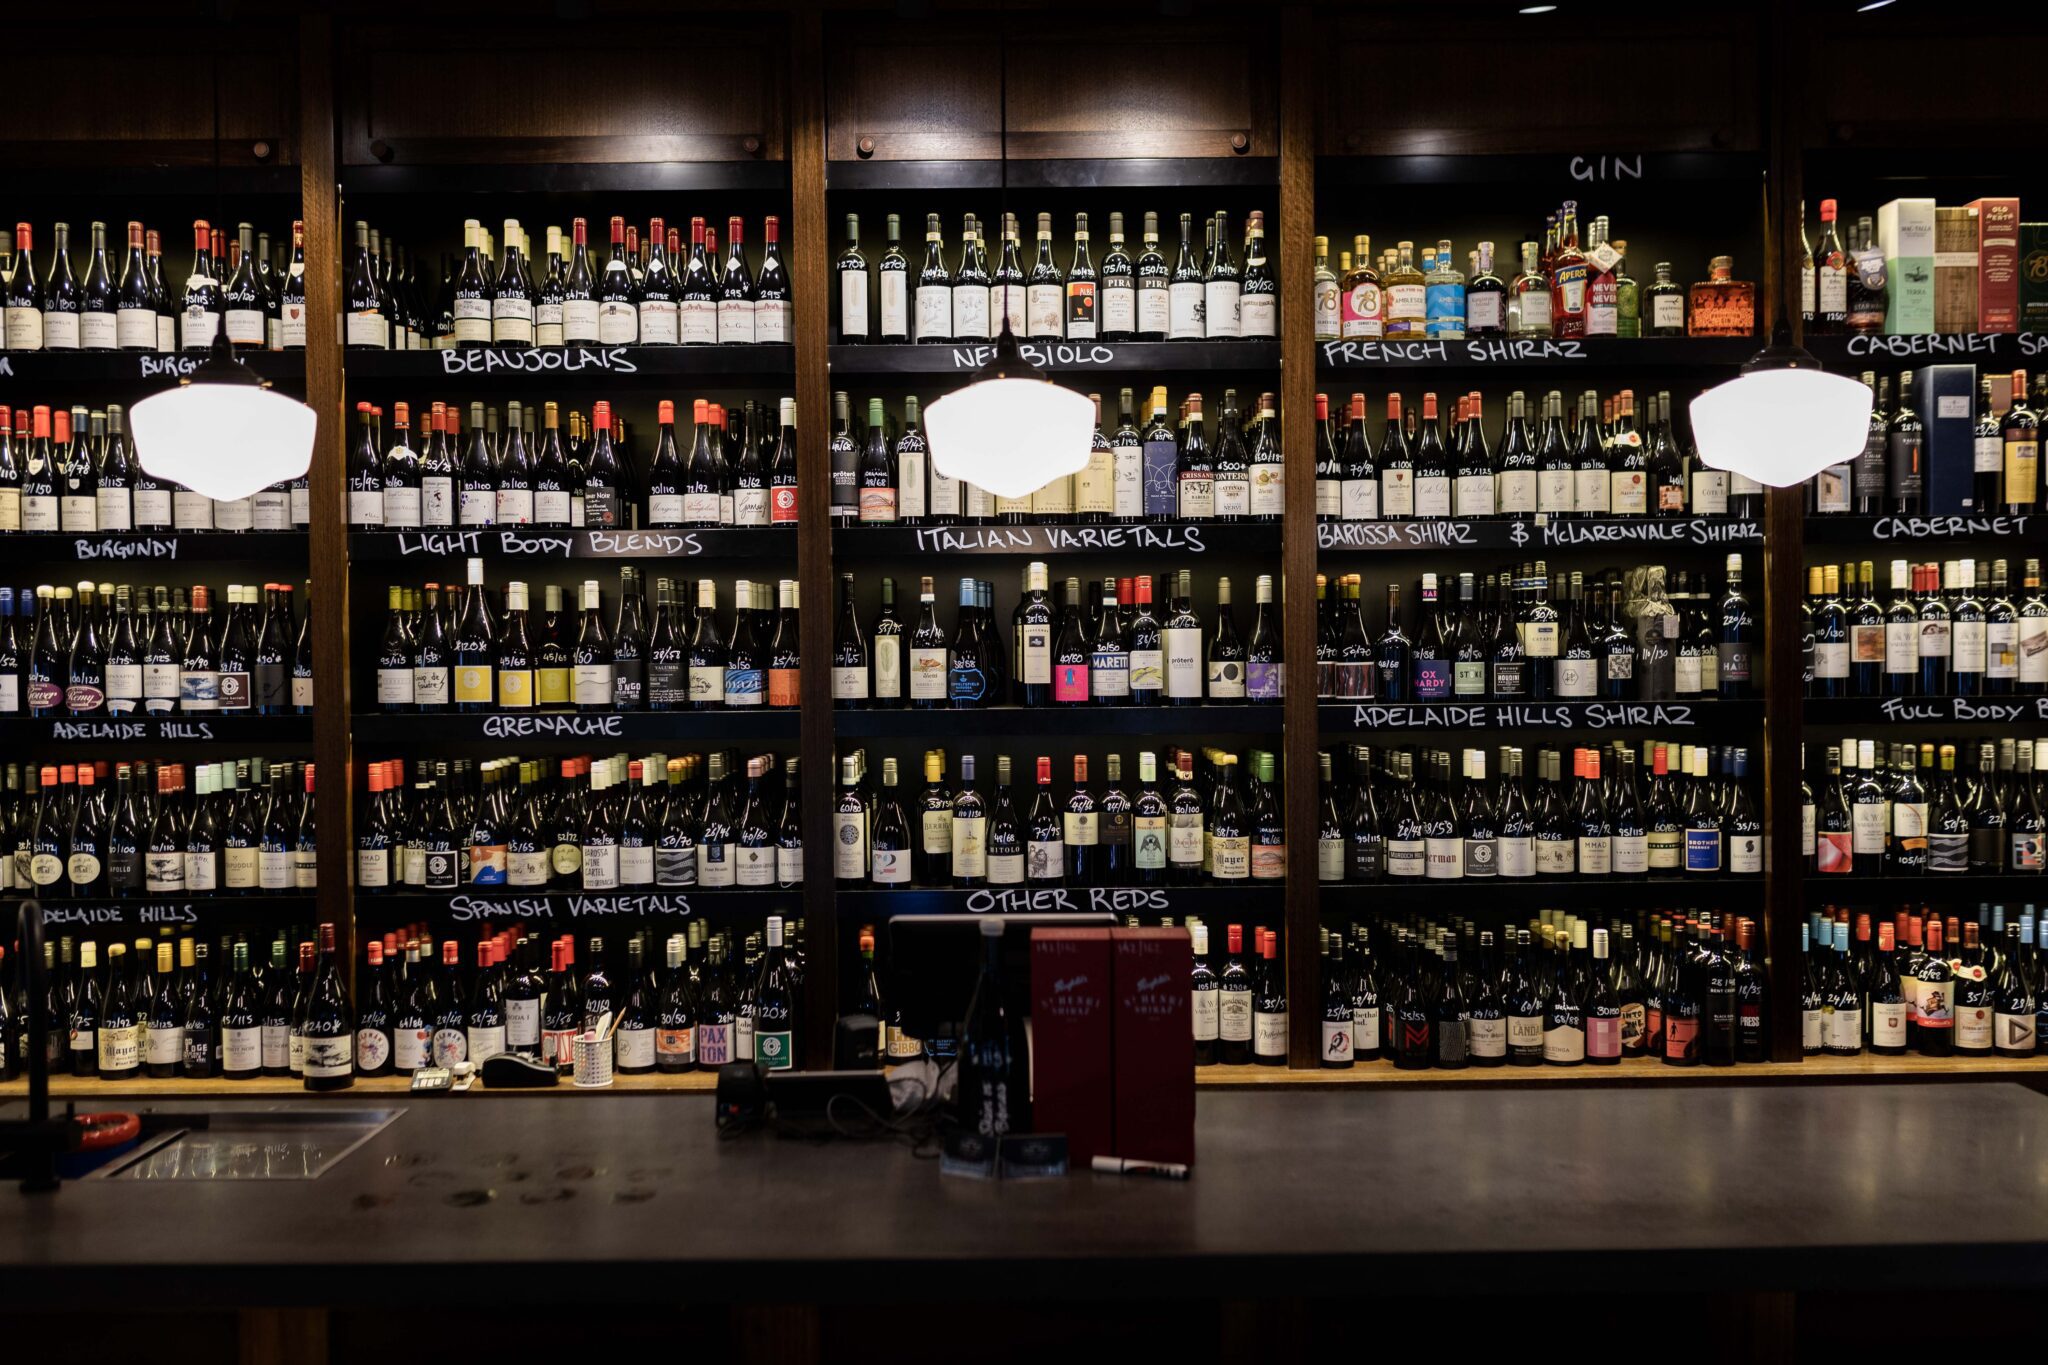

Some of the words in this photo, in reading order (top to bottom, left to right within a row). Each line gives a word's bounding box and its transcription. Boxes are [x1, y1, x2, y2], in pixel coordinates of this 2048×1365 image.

[1570, 156, 1642, 180] GIN
[1108, 279, 1132, 288] PIRA
[1146, 279, 1168, 288] PIRA
[1244, 277, 1274, 292] 130/150
[456, 290, 482, 299] 85/105
[496, 290, 524, 300] 115/135
[352, 298, 380, 308] 100/120
[1847, 333, 2002, 356] CABERNET
[953, 345, 1114, 368] NEBIOLO
[1324, 340, 1447, 366] FRENCH
[1470, 340, 1588, 361] SHIRAZ
[442, 348, 638, 374] BEAUJOLAIS
[1458, 467, 1492, 476] 105/125
[1316, 522, 1402, 548] BAROSSA
[1404, 522, 1478, 546] SHIRAZ
[1690, 520, 1764, 544] SHIRAZ
[1872, 516, 2028, 539] CABERNET
[398, 532, 483, 556] LIGHT
[500, 531, 573, 558] BODY
[588, 532, 702, 555] BLENDS
[916, 526, 1033, 552] ITALIAN
[1046, 526, 1206, 552] VARIETALS
[74, 538, 178, 560] BURGUNDY
[1096, 644, 1120, 652] 30/50
[1342, 646, 1372, 658] 50/70
[1566, 650, 1591, 660] 35/55
[500, 656, 526, 667] 45/65
[1060, 653, 1083, 664] 40/60
[1422, 671, 1436, 679] OX
[1414, 679, 1446, 688] HARDY
[1354, 704, 1486, 728] ADELAIDE
[1496, 704, 1573, 728] HILLS
[1586, 704, 1695, 728] SHIRAZ
[1880, 698, 1944, 721] FULL
[1952, 698, 2024, 722] BODY
[54, 722, 146, 739] ADELAIDE
[160, 722, 214, 740] HILLS
[483, 716, 623, 738] GRENACHE
[1175, 804, 1200, 814] 80/100
[662, 832, 692, 847] 50/70
[990, 846, 1020, 854] MITOLO
[584, 858, 600, 867] WINE
[450, 895, 554, 921] SPANISH
[567, 894, 692, 918] VARIETALS
[966, 888, 1078, 912] OTHER
[1089, 888, 1170, 910] REDS
[42, 906, 123, 924] DELAIDE
[139, 906, 198, 923] HILLS
[586, 998, 610, 1012] 42/62
[661, 1008, 686, 1026] 30/50
[1740, 1016, 1760, 1027] PRESS
[700, 1027, 726, 1042] PAX
[700, 1046, 726, 1063] TON
